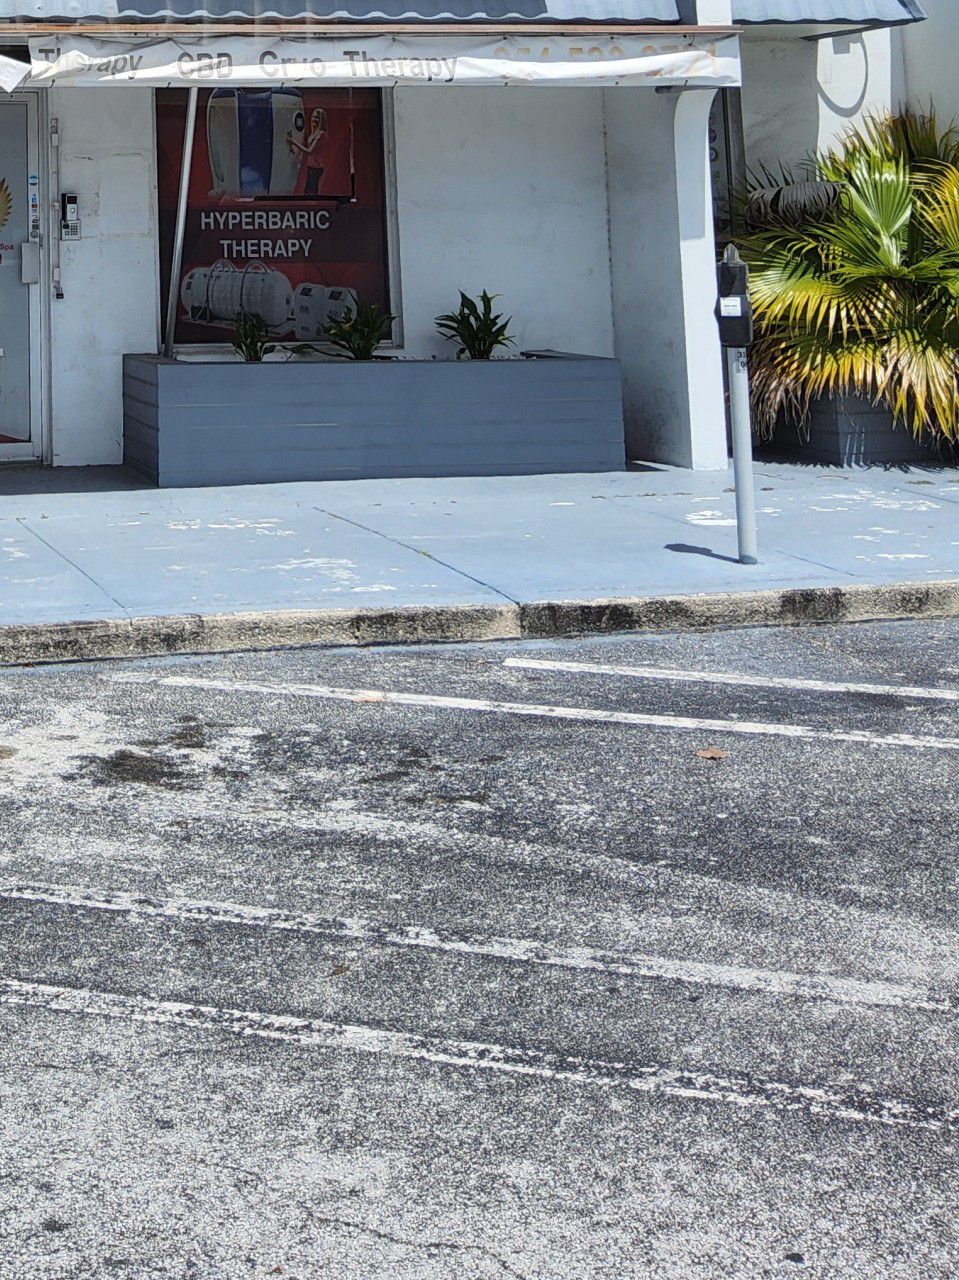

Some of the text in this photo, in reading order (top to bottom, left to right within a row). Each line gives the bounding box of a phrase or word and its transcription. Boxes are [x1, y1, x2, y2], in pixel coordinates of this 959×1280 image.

[177, 52, 233, 78] CBD
[343, 51, 458, 82] Therapy
[200, 210, 330, 230] HYPERBARIC
[0, 243, 14, 251] Spa
[220, 239, 312, 258] THERAPY
